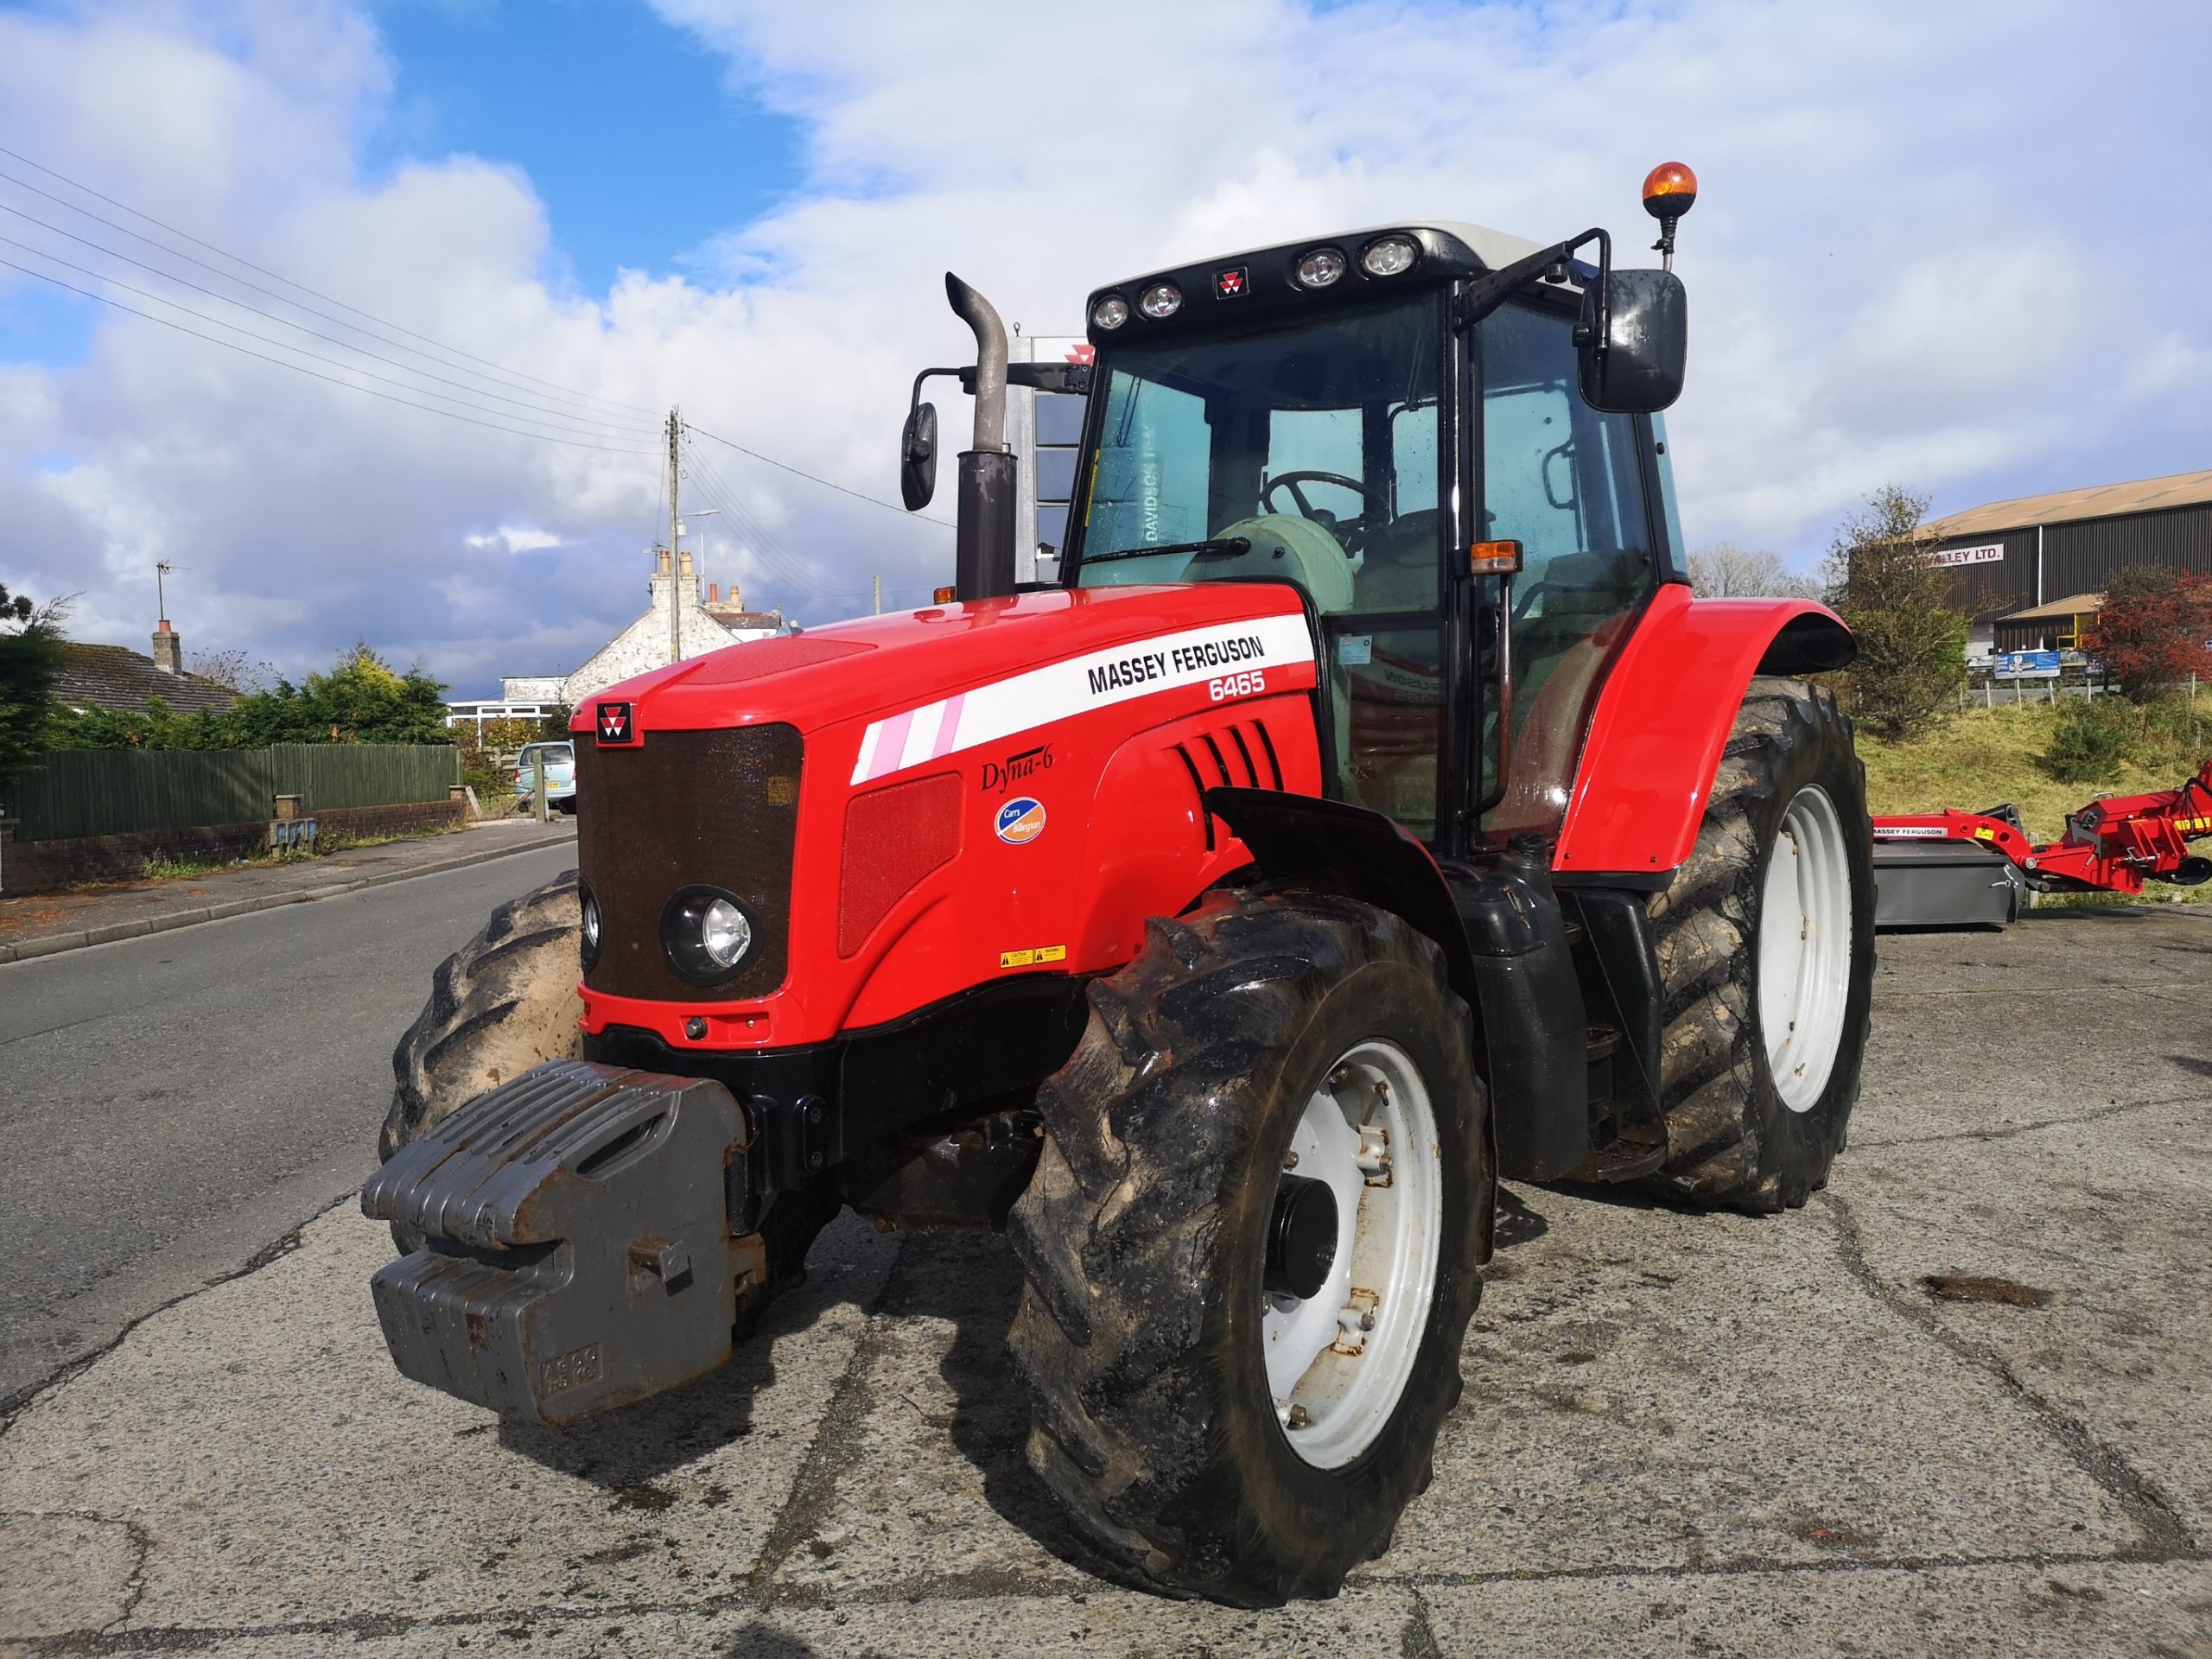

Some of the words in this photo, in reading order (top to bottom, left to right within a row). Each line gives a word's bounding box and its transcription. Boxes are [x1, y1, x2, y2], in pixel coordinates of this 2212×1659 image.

[1974, 548, 2000, 561] LTD.
[1088, 652, 1166, 695] MASSEY
[1172, 636, 1265, 673] FERGUSON
[1209, 671, 1266, 702] 6465
[980, 742, 1053, 795] Dyna-6
[1004, 809, 1020, 818] Carrs
